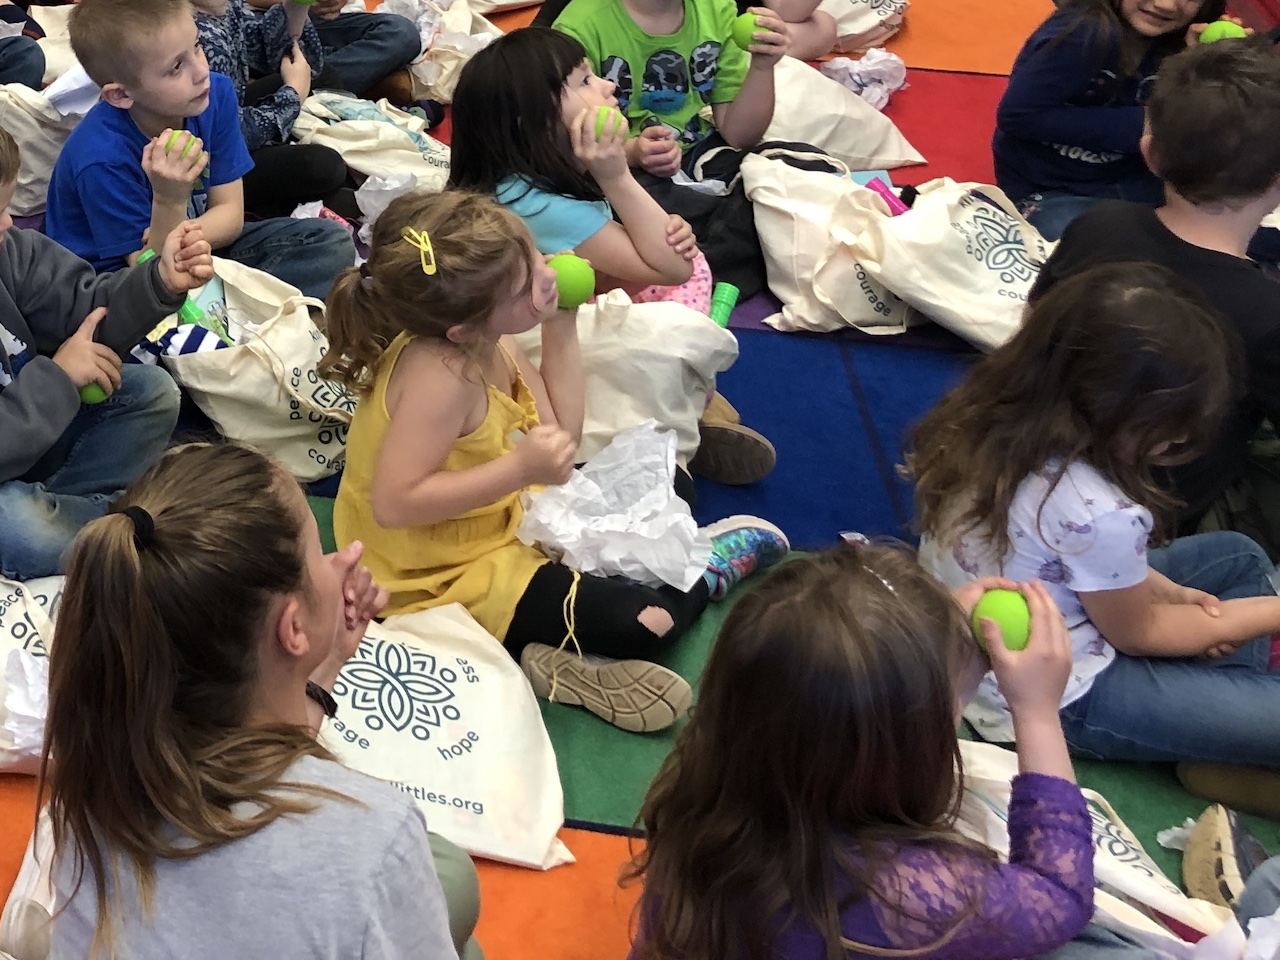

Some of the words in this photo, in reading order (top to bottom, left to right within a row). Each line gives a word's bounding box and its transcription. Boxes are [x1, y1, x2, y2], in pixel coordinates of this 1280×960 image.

[423, 154, 450, 169] coura
[854, 263, 891, 317] courage
[289, 367, 302, 420] pece
[437, 730, 480, 761] hope
